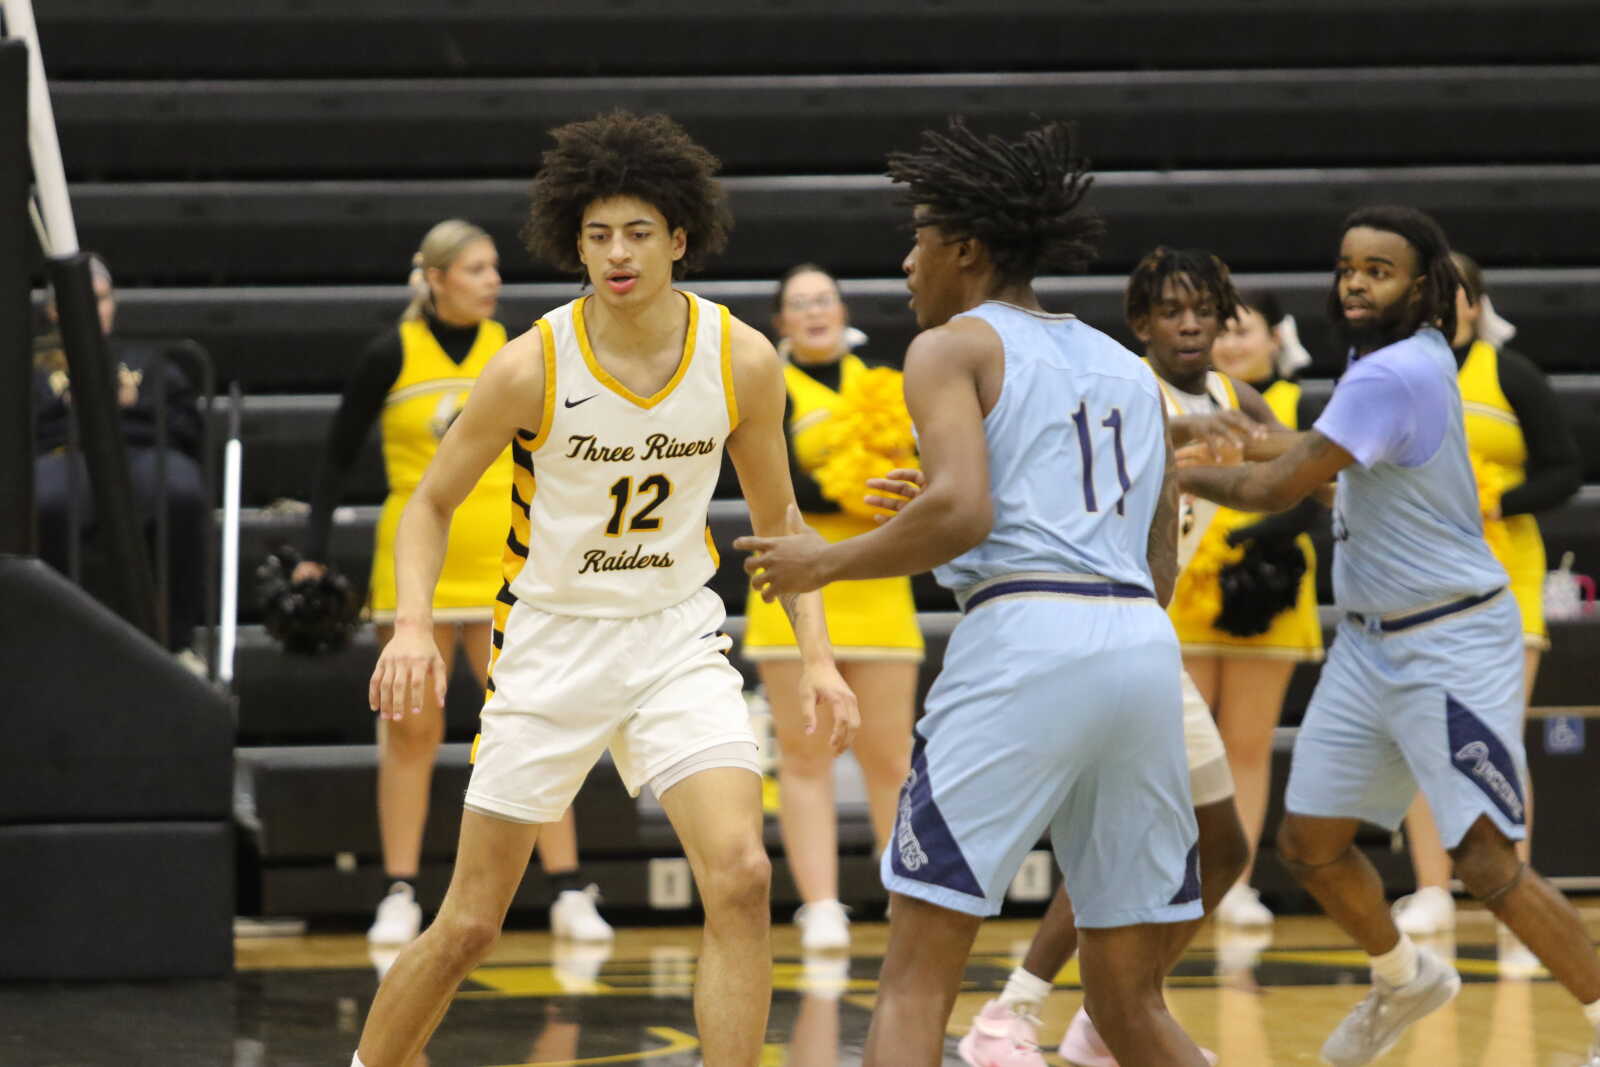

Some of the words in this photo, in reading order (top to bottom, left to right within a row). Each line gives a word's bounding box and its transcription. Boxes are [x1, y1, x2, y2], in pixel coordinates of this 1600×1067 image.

[565, 434, 635, 463] Three
[640, 432, 717, 461] Rivers
[1070, 399, 1131, 517] 11
[604, 473, 676, 538] 12
[577, 544, 675, 575] Raiders
